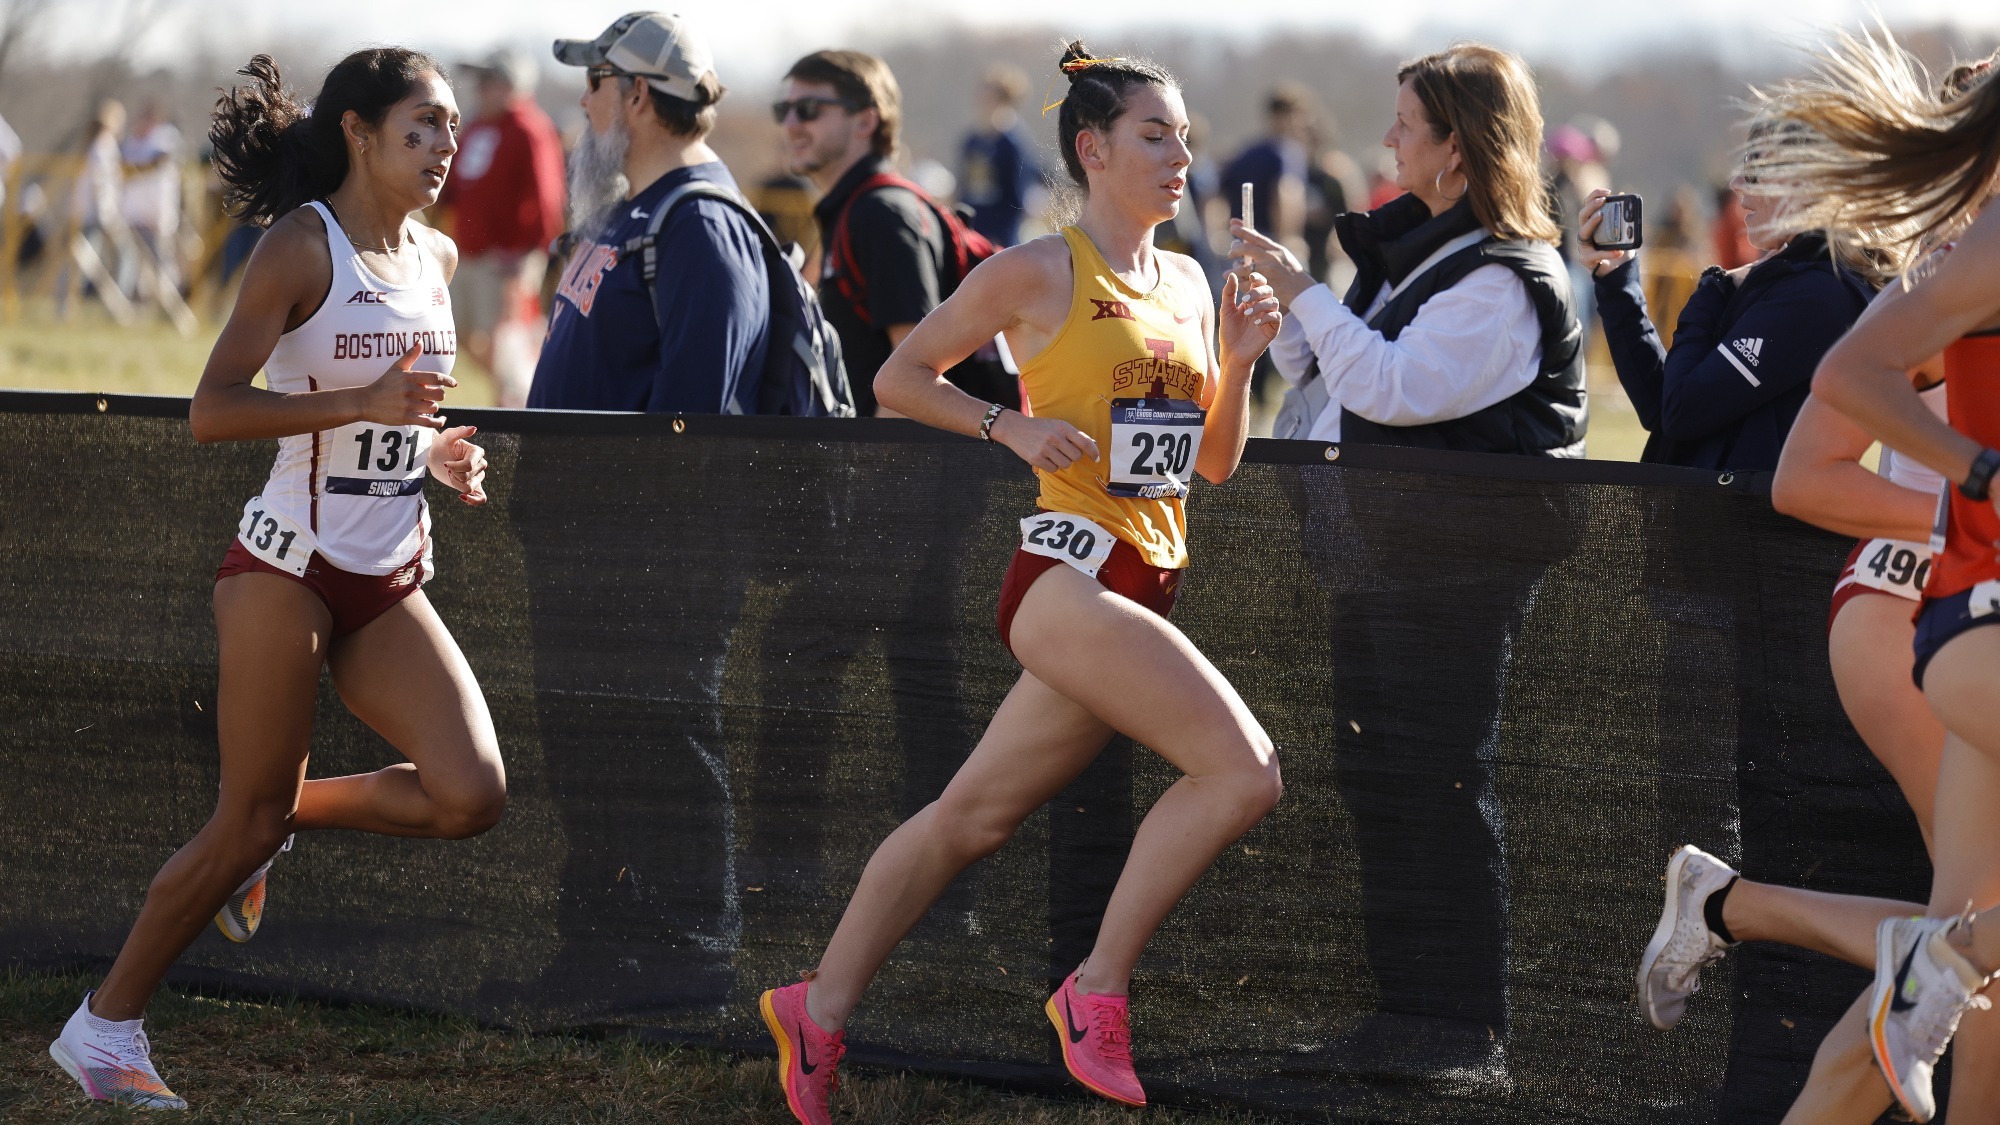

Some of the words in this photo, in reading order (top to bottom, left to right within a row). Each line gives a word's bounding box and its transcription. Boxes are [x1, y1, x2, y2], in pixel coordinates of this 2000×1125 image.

[346, 290, 388, 303] ACC
[333, 331, 407, 360] BOSTON
[1732, 339, 1760, 367] adidas
[1113, 358, 1201, 398] STATE
[354, 428, 420, 472] 131
[1129, 431, 1192, 477] 230
[367, 481, 401, 496] SINGH
[246, 509, 297, 561] 131
[1027, 519, 1096, 561] 230
